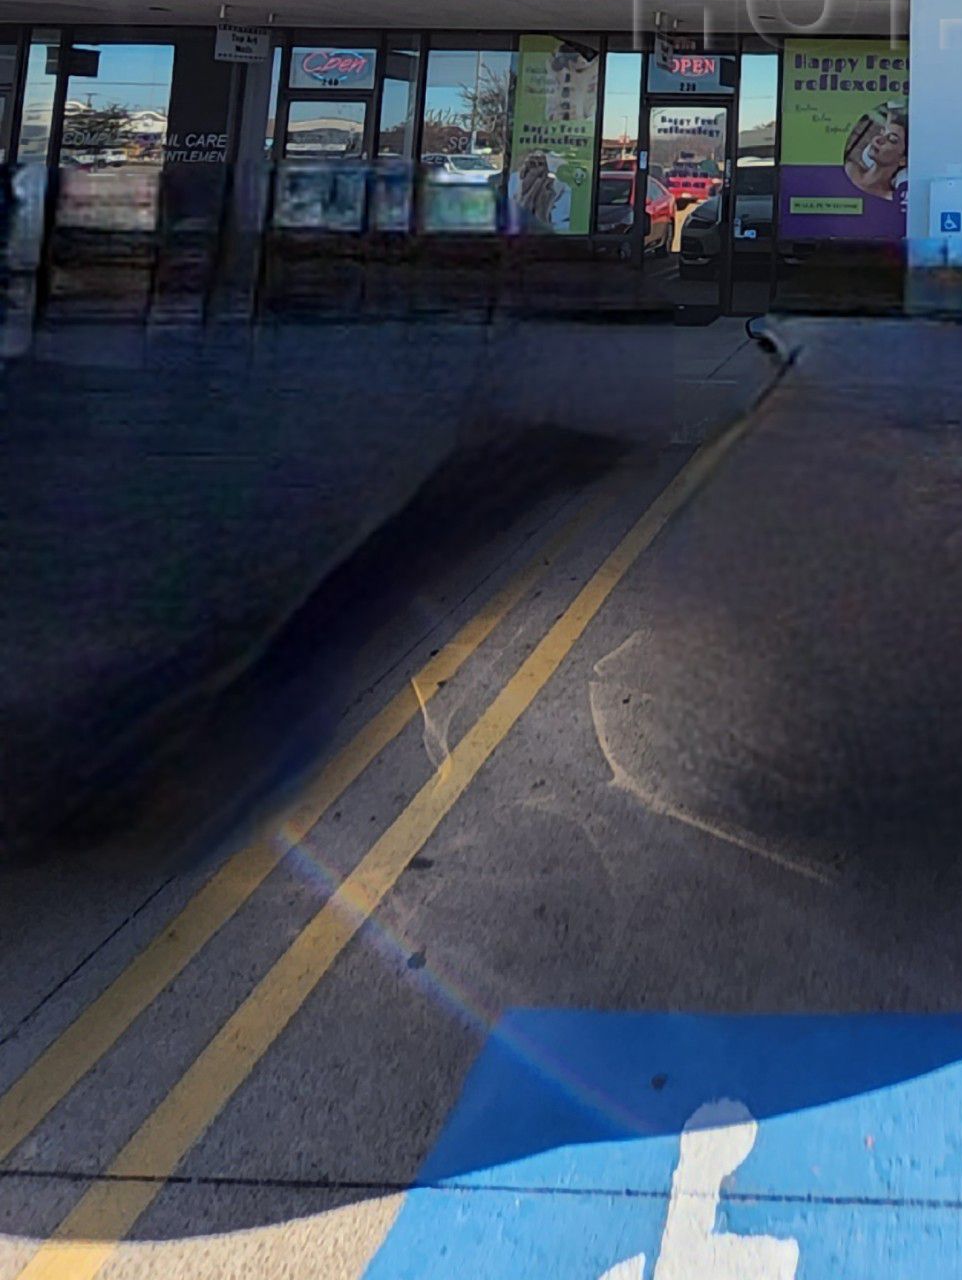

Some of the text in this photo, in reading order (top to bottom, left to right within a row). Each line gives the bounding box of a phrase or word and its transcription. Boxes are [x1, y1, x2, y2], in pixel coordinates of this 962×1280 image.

[795, 54, 858, 72] Happy
[795, 74, 910, 95] reflexolog
[185, 134, 228, 148] CARE
